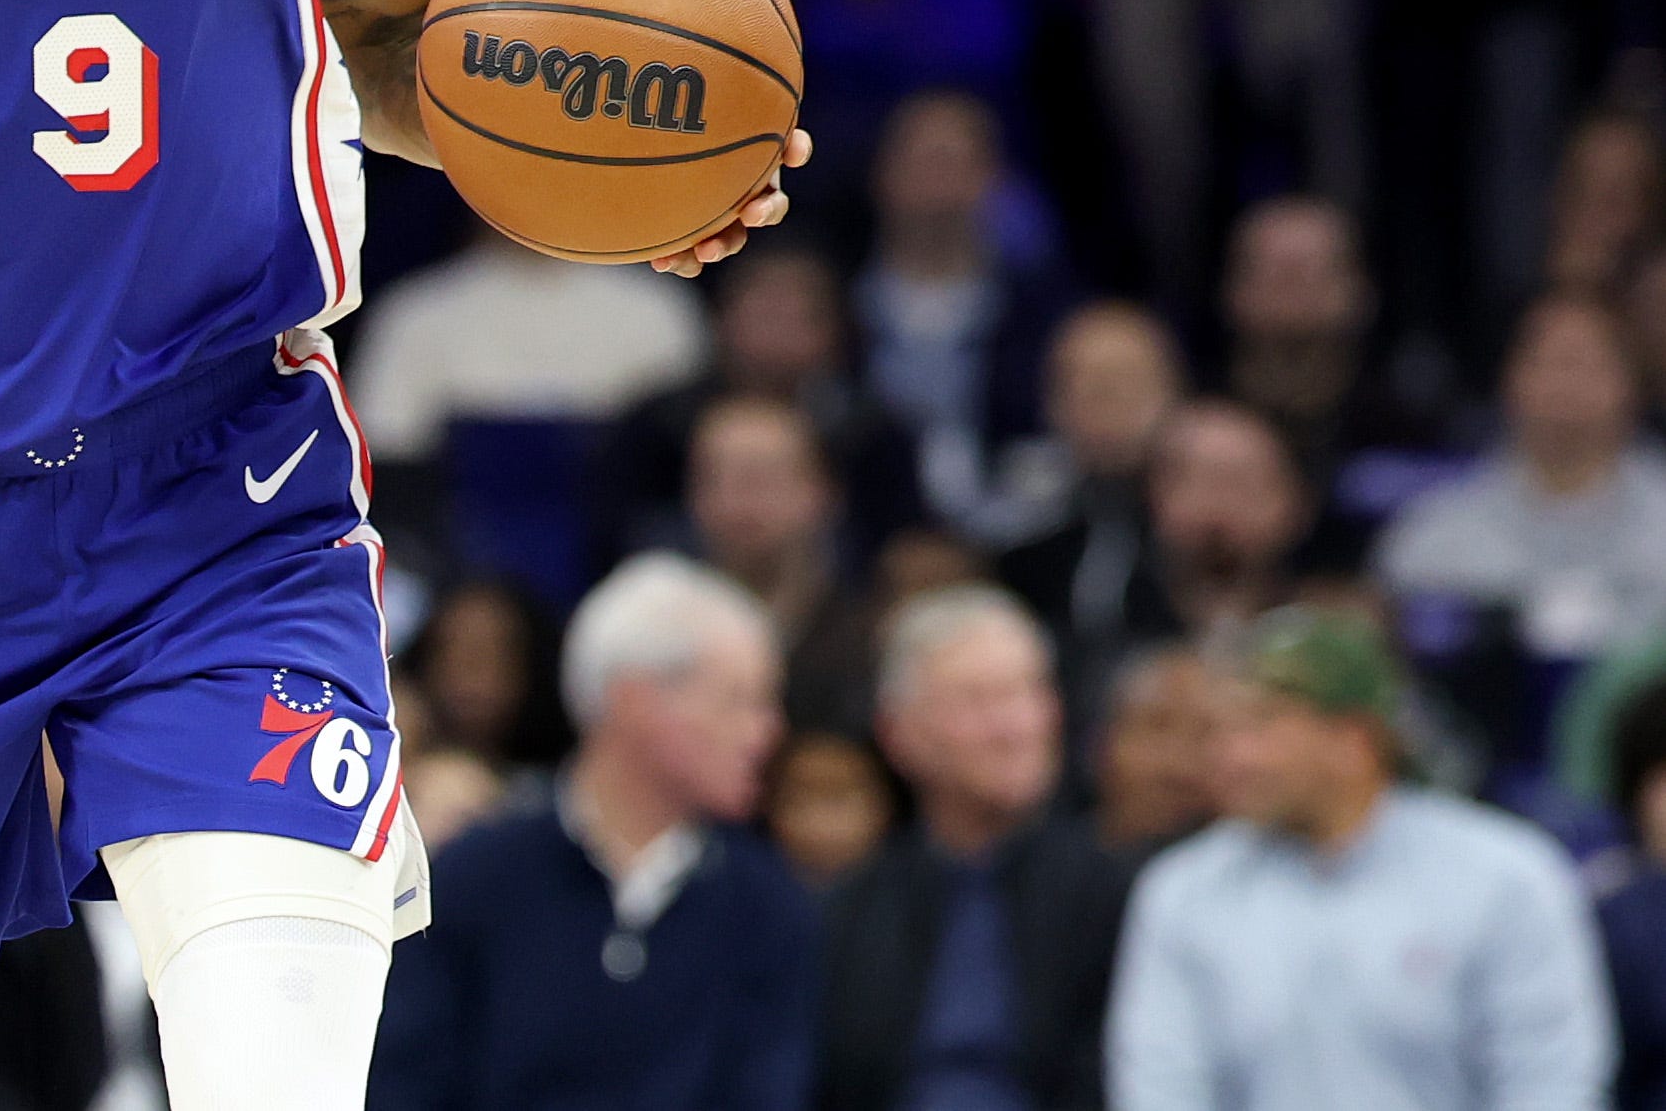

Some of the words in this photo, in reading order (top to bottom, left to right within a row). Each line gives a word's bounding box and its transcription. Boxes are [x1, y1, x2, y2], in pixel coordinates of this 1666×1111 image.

[33, 14, 159, 192] 9
[464, 29, 707, 134] Wilson
[248, 693, 372, 808] 76
